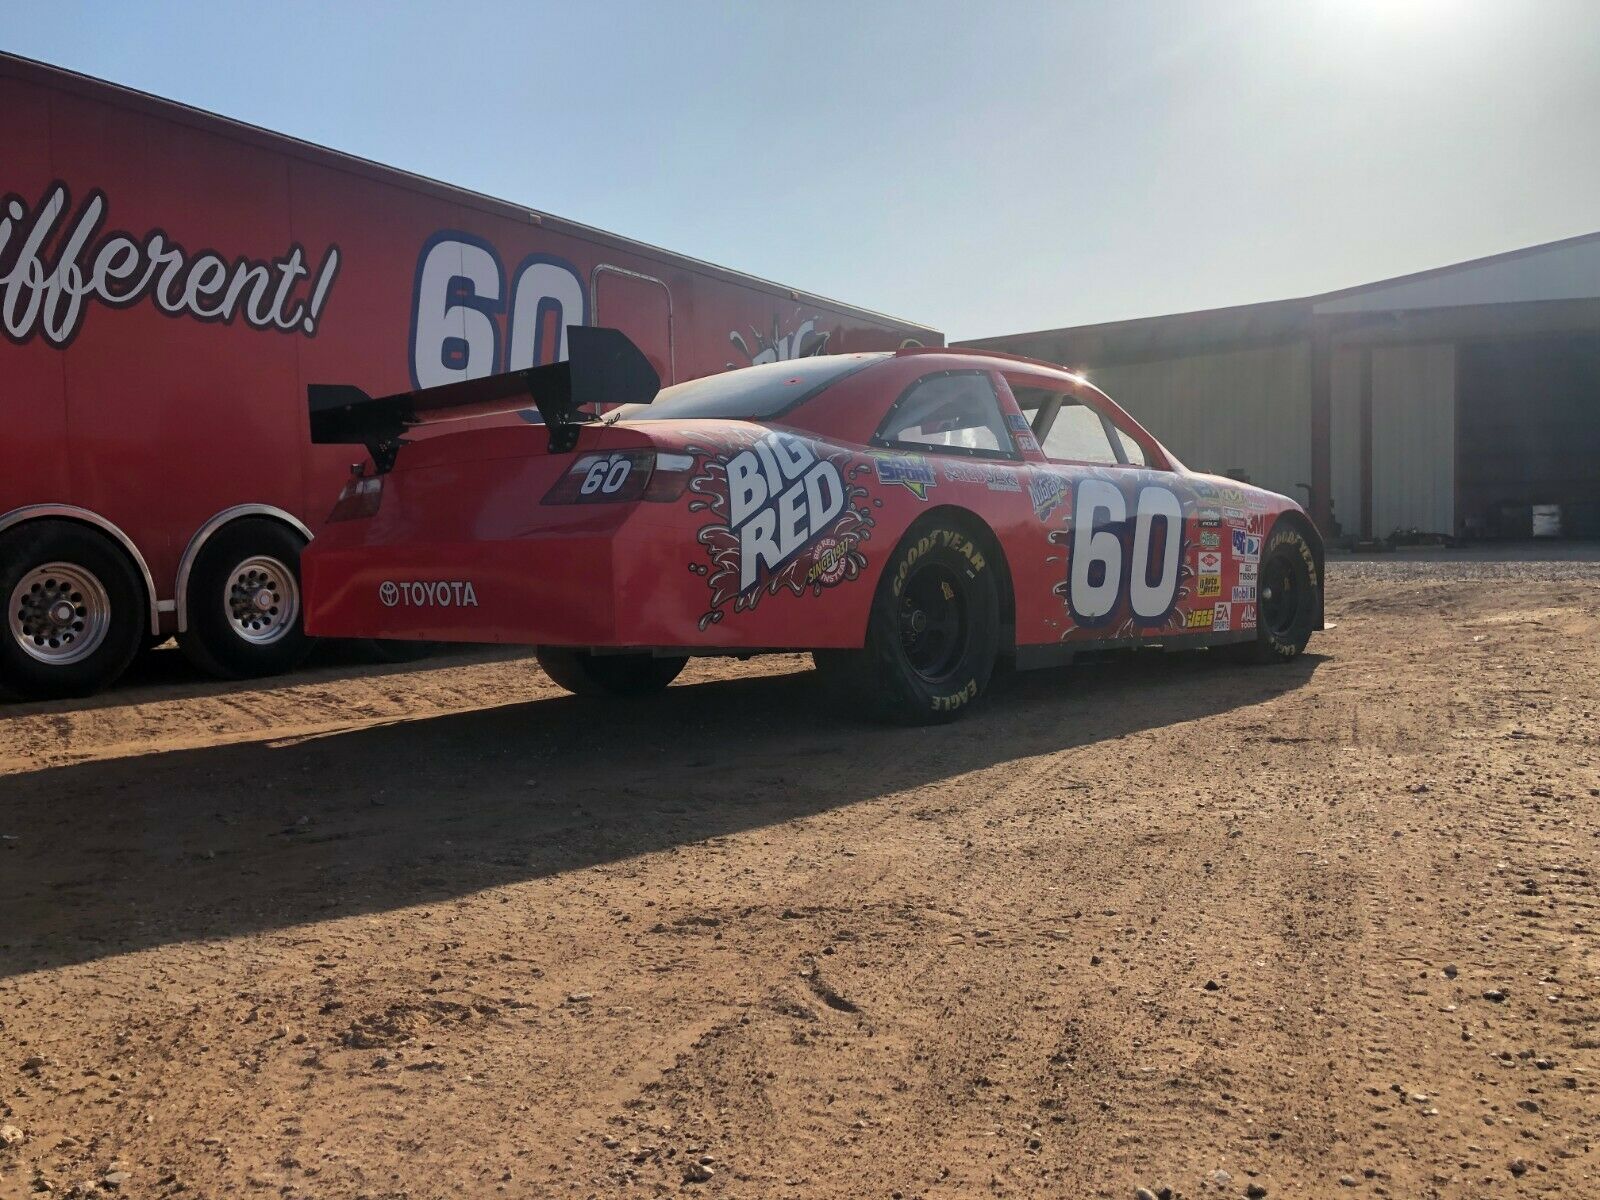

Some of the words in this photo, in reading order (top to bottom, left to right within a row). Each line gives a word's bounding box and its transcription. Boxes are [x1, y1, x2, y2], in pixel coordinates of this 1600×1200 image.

[411, 236, 589, 393] 60
[580, 459, 632, 494] 60
[726, 431, 818, 529] BIG
[740, 459, 844, 592] RED
[893, 529, 986, 597] GOODYEAR
[1071, 479, 1183, 618] 60
[808, 551, 833, 583] SINCE
[400, 581, 478, 606] TOYOTA
[1233, 587, 1249, 599] Mobil
[1188, 609, 1214, 627] JEGS
[1215, 604, 1230, 620] EA
